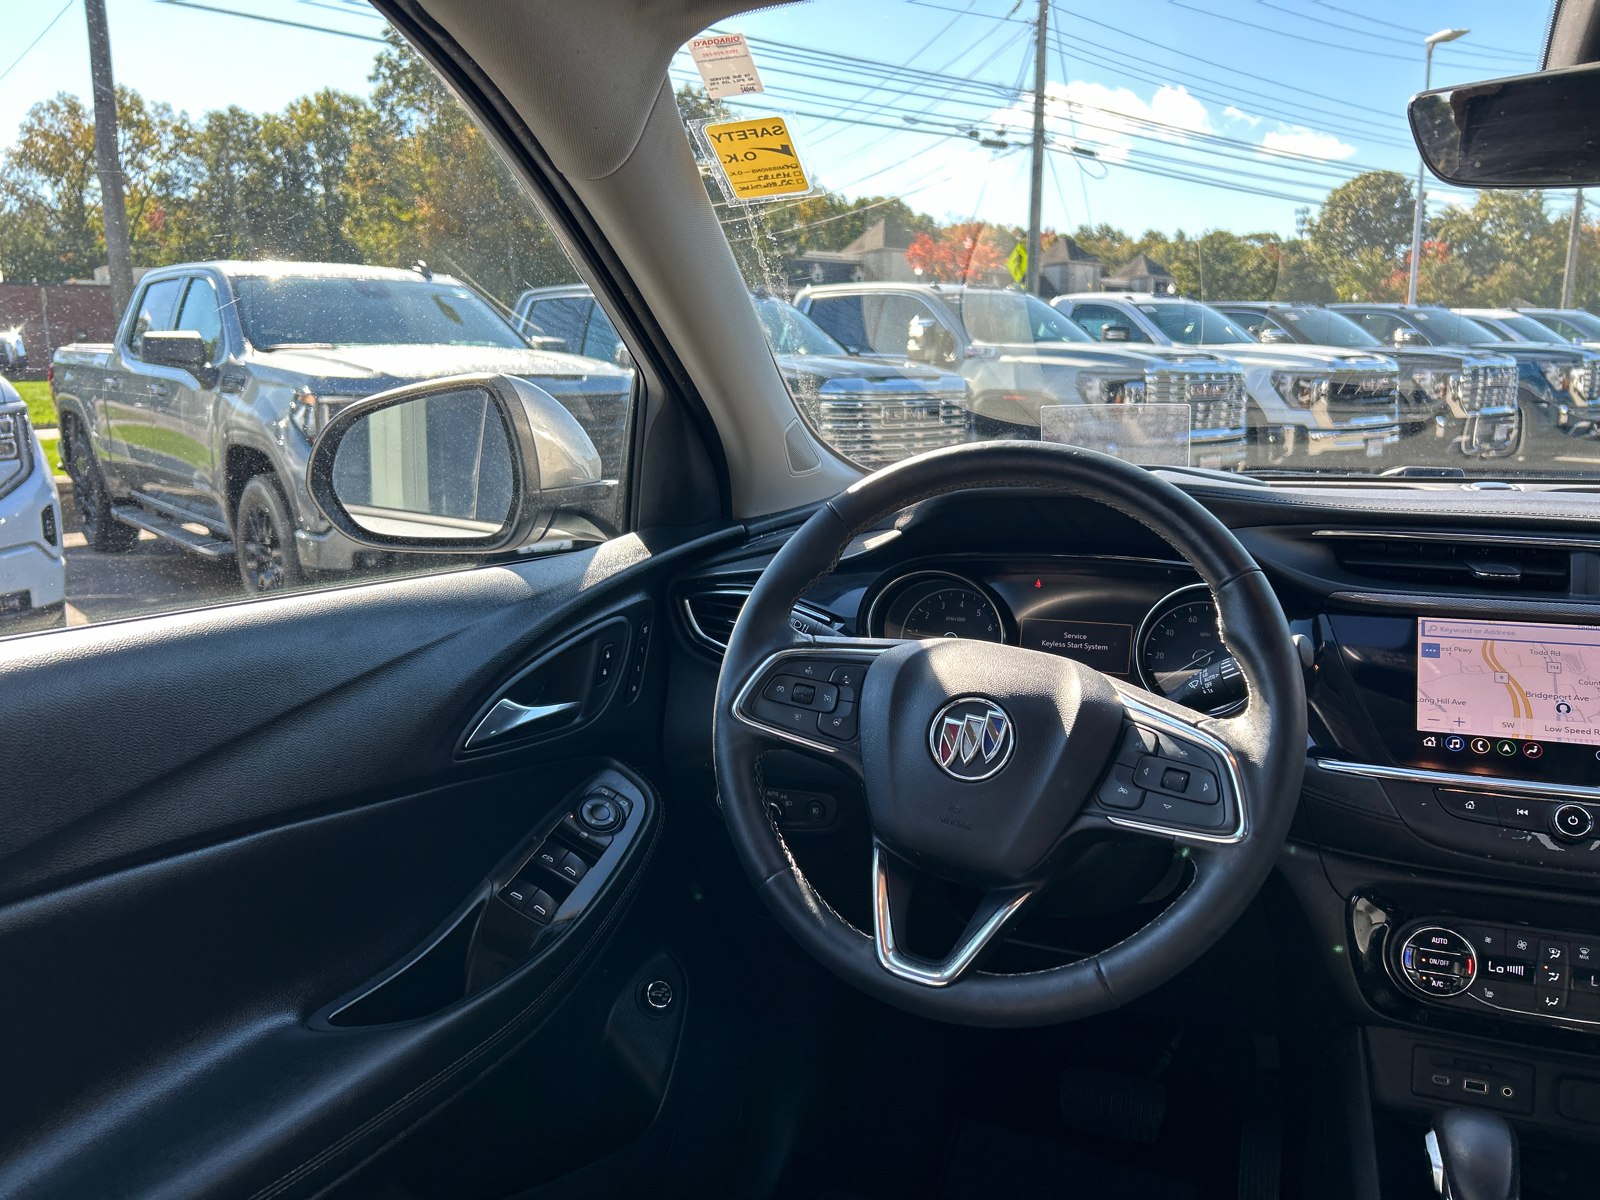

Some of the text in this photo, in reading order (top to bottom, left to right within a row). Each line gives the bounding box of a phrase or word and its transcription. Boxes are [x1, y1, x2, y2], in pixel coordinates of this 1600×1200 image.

[693, 35, 740, 47] D'ADDARIO
[940, 602, 946, 610] 3
[976, 608, 981, 617] 5
[1188, 615, 1198, 623] 60
[1063, 631, 1087, 640] Service
[1165, 628, 1175, 636] 40
[1439, 626, 1473, 634] Keyword
[1483, 628, 1516, 636] Address
[1041, 639, 1109, 651] Keyless Start System
[1453, 646, 1472, 654] Pkwy
[1529, 648, 1549, 656] Todd
[1155, 651, 1165, 660] 20
[1203, 674, 1216, 683] AUTO
[1204, 681, 1213, 689] OFF
[1525, 690, 1590, 702] Bridgeport Ave
[1417, 697, 1435, 706] ong
[1501, 721, 1515, 729] SW
[1544, 725, 1562, 733] Low
[1564, 726, 1592, 736] Speed
[1431, 936, 1448, 945] AUTO
[1429, 957, 1450, 966] ON/OFF
[1488, 960, 1504, 974] Lo
[1431, 980, 1444, 988] A/C
